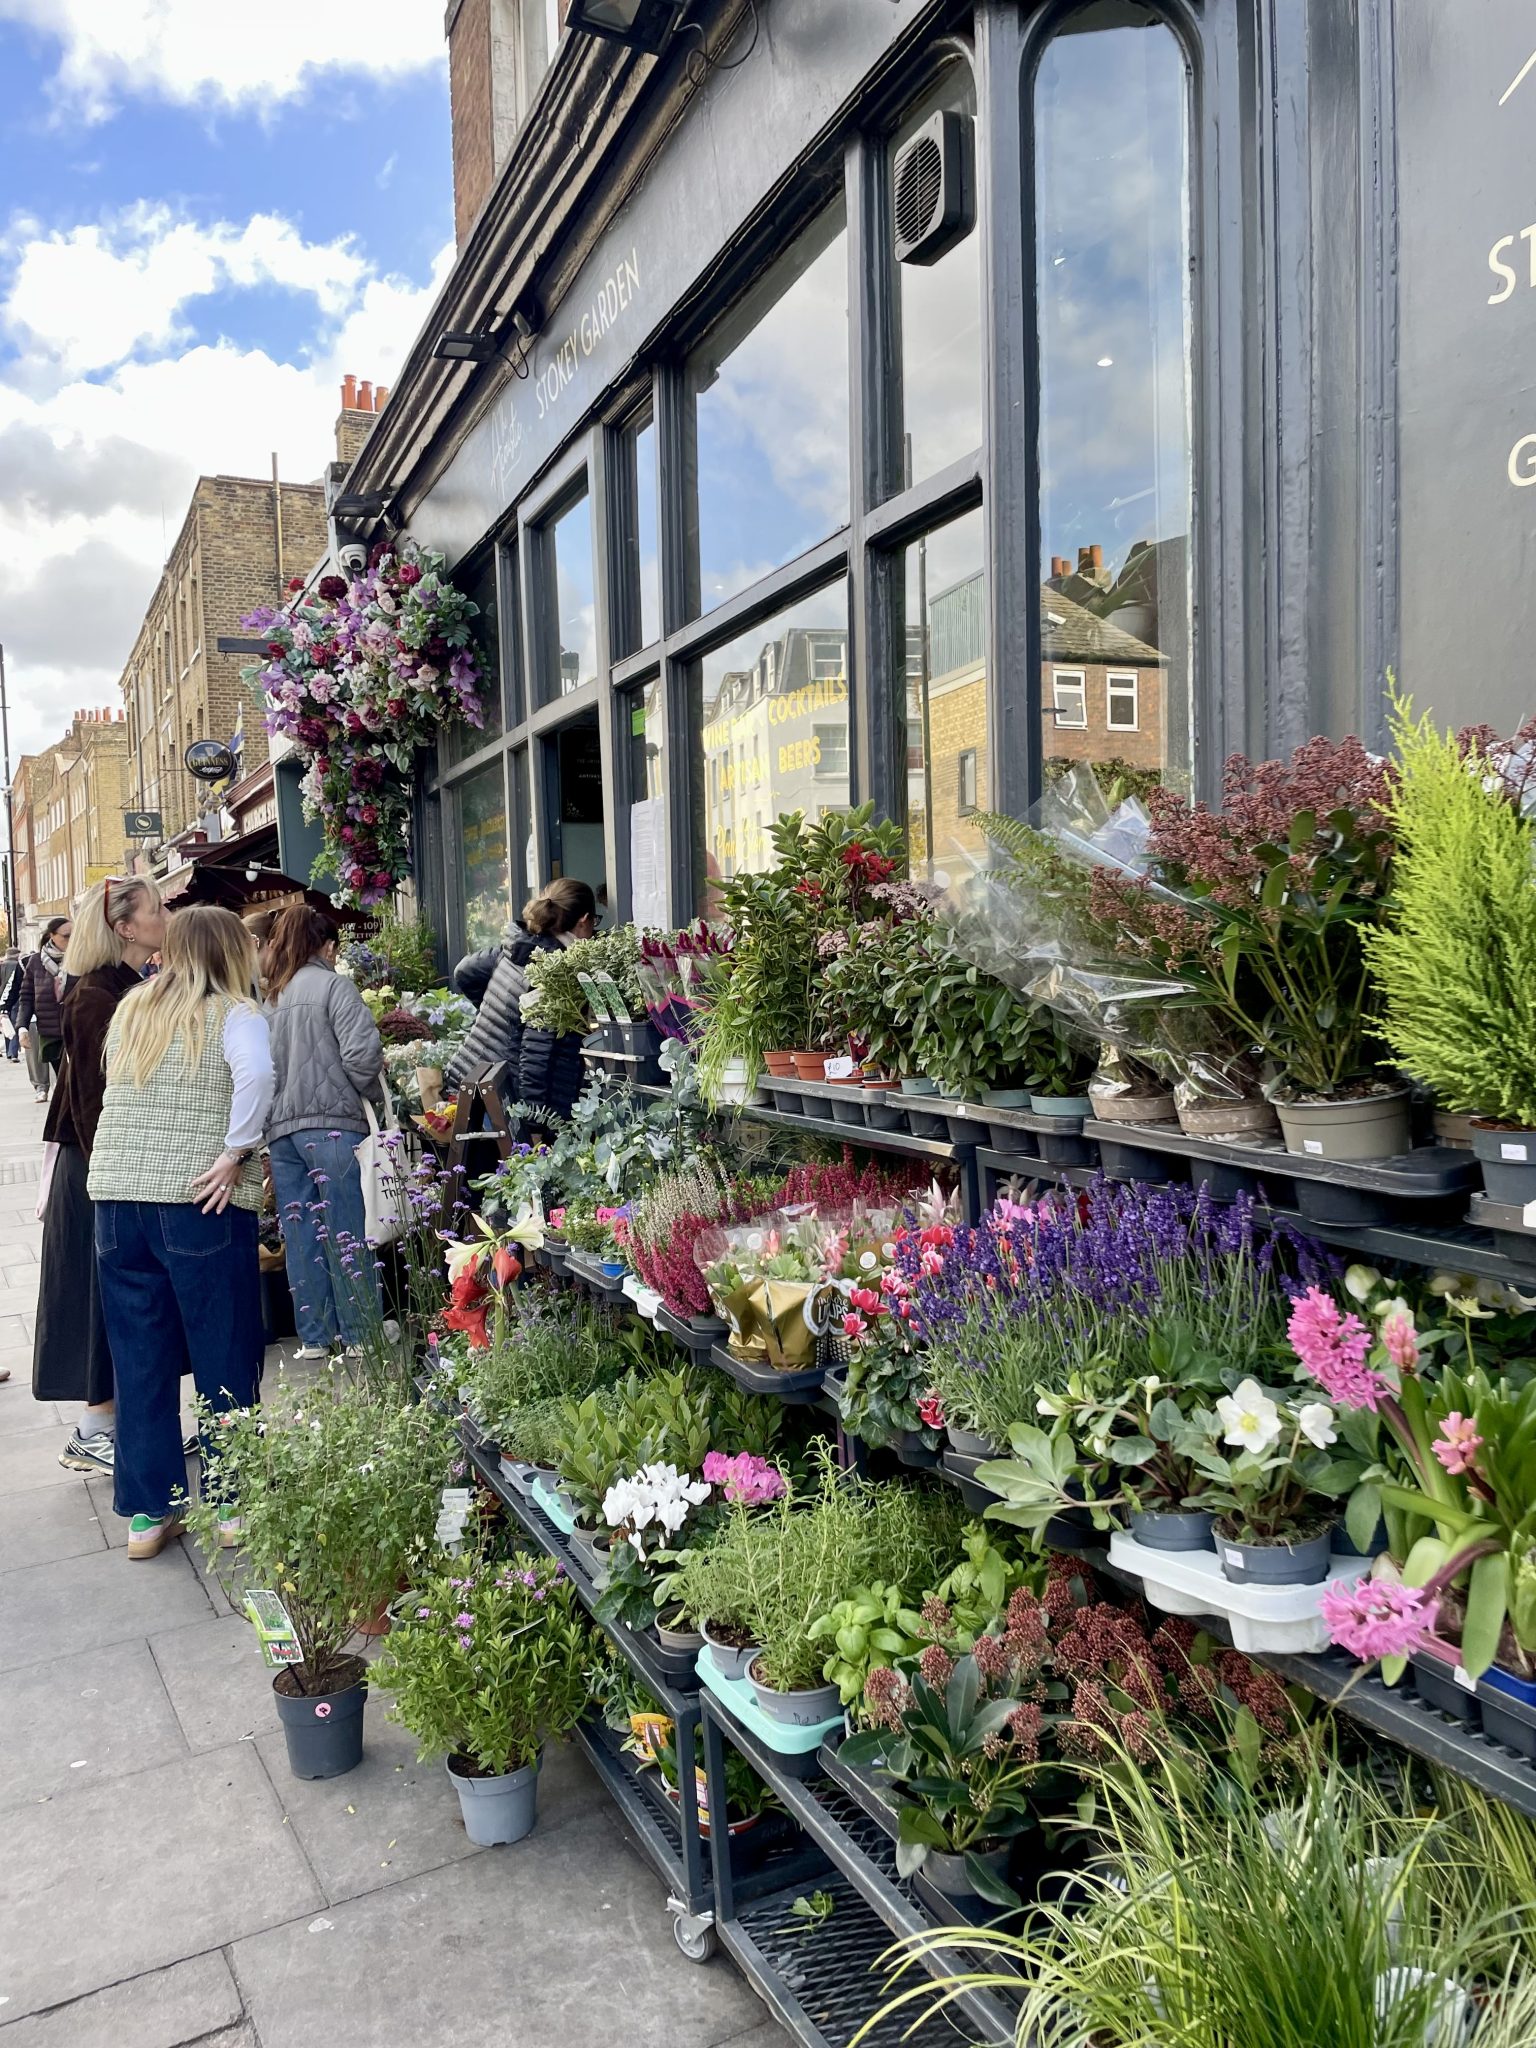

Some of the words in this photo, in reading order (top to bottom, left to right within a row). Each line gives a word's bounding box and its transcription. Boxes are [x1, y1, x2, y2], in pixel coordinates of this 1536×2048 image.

[535, 328, 579, 420] STOKEY
[580, 247, 641, 357] GARDEN
[767, 671, 848, 727] COCKTAILS
[719, 752, 769, 792] ARTISAN
[777, 735, 822, 774] BEERS
[363, 922, 379, 930] 109
